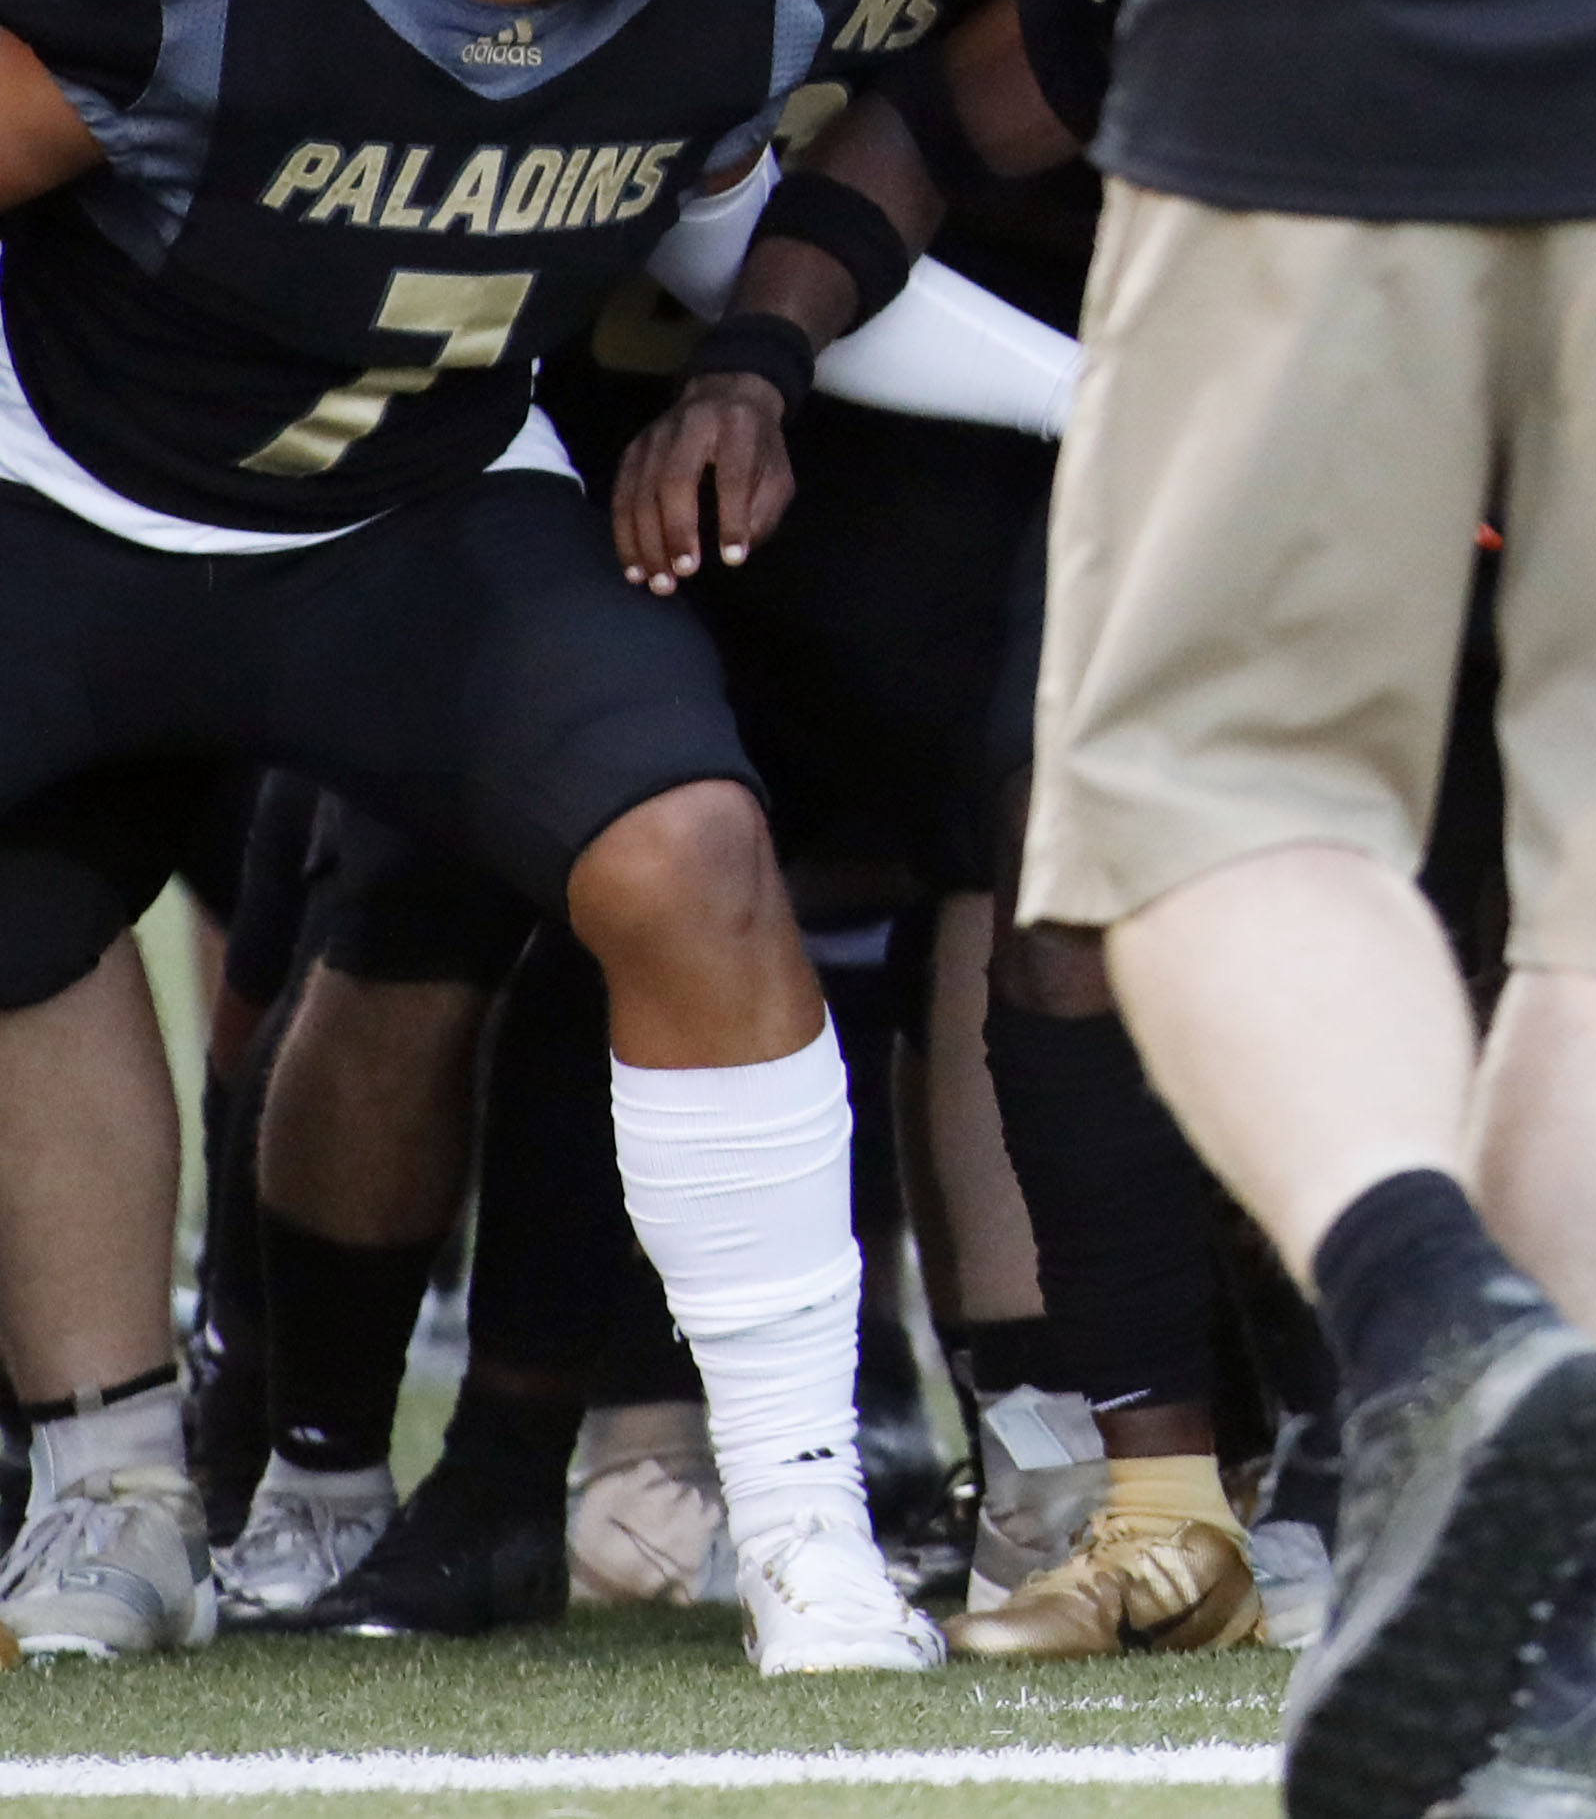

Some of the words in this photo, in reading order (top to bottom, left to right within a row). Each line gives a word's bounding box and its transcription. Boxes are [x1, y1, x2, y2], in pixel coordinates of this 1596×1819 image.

[461, 42, 542, 66] adidas
[258, 139, 690, 238] PALADINS
[239, 268, 541, 479] 7
